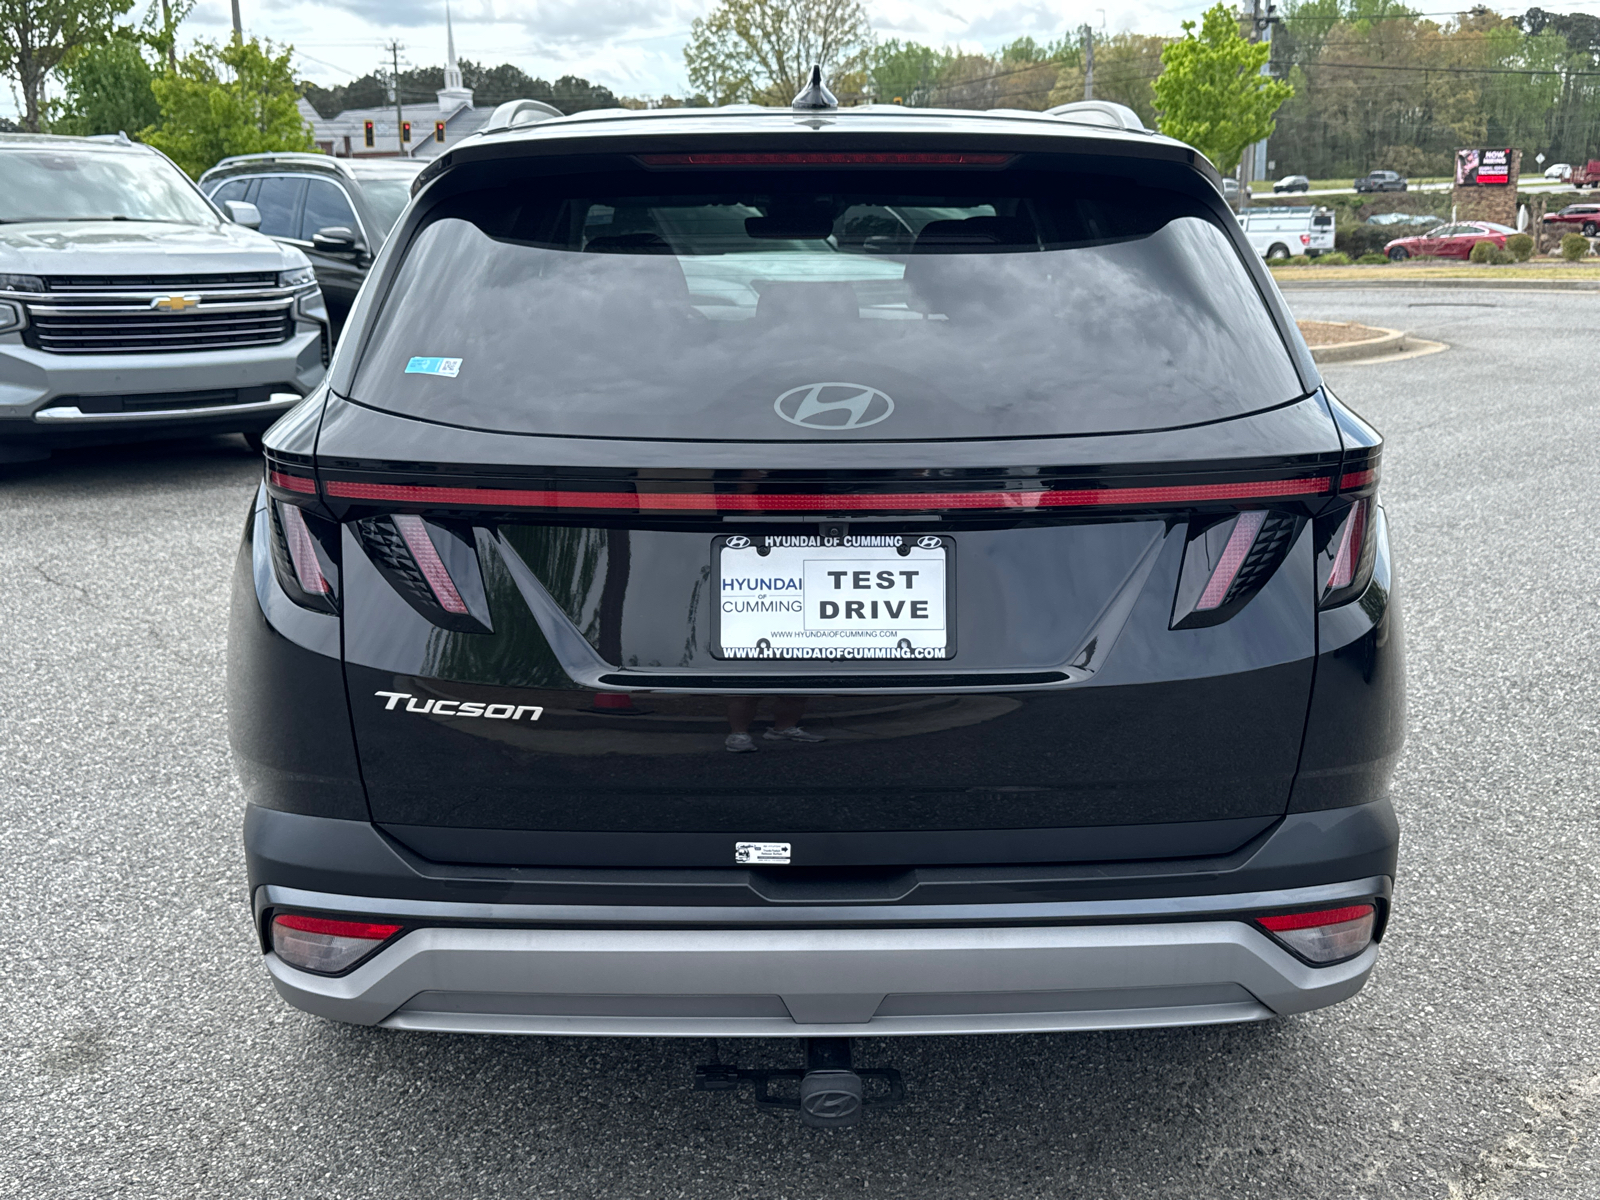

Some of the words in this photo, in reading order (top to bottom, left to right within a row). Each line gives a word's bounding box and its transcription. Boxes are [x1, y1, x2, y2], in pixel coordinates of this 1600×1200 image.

[765, 536, 821, 547] HYUNDAI
[824, 537, 840, 547] OF
[843, 536, 903, 547] CUMMING
[722, 578, 803, 591] HYUNDAI
[827, 571, 919, 589] TEST
[722, 601, 803, 613] CUMMING
[819, 600, 929, 619] DRIVE
[723, 647, 946, 659] WWW.HYUNDAIOFCUMMING.COM
